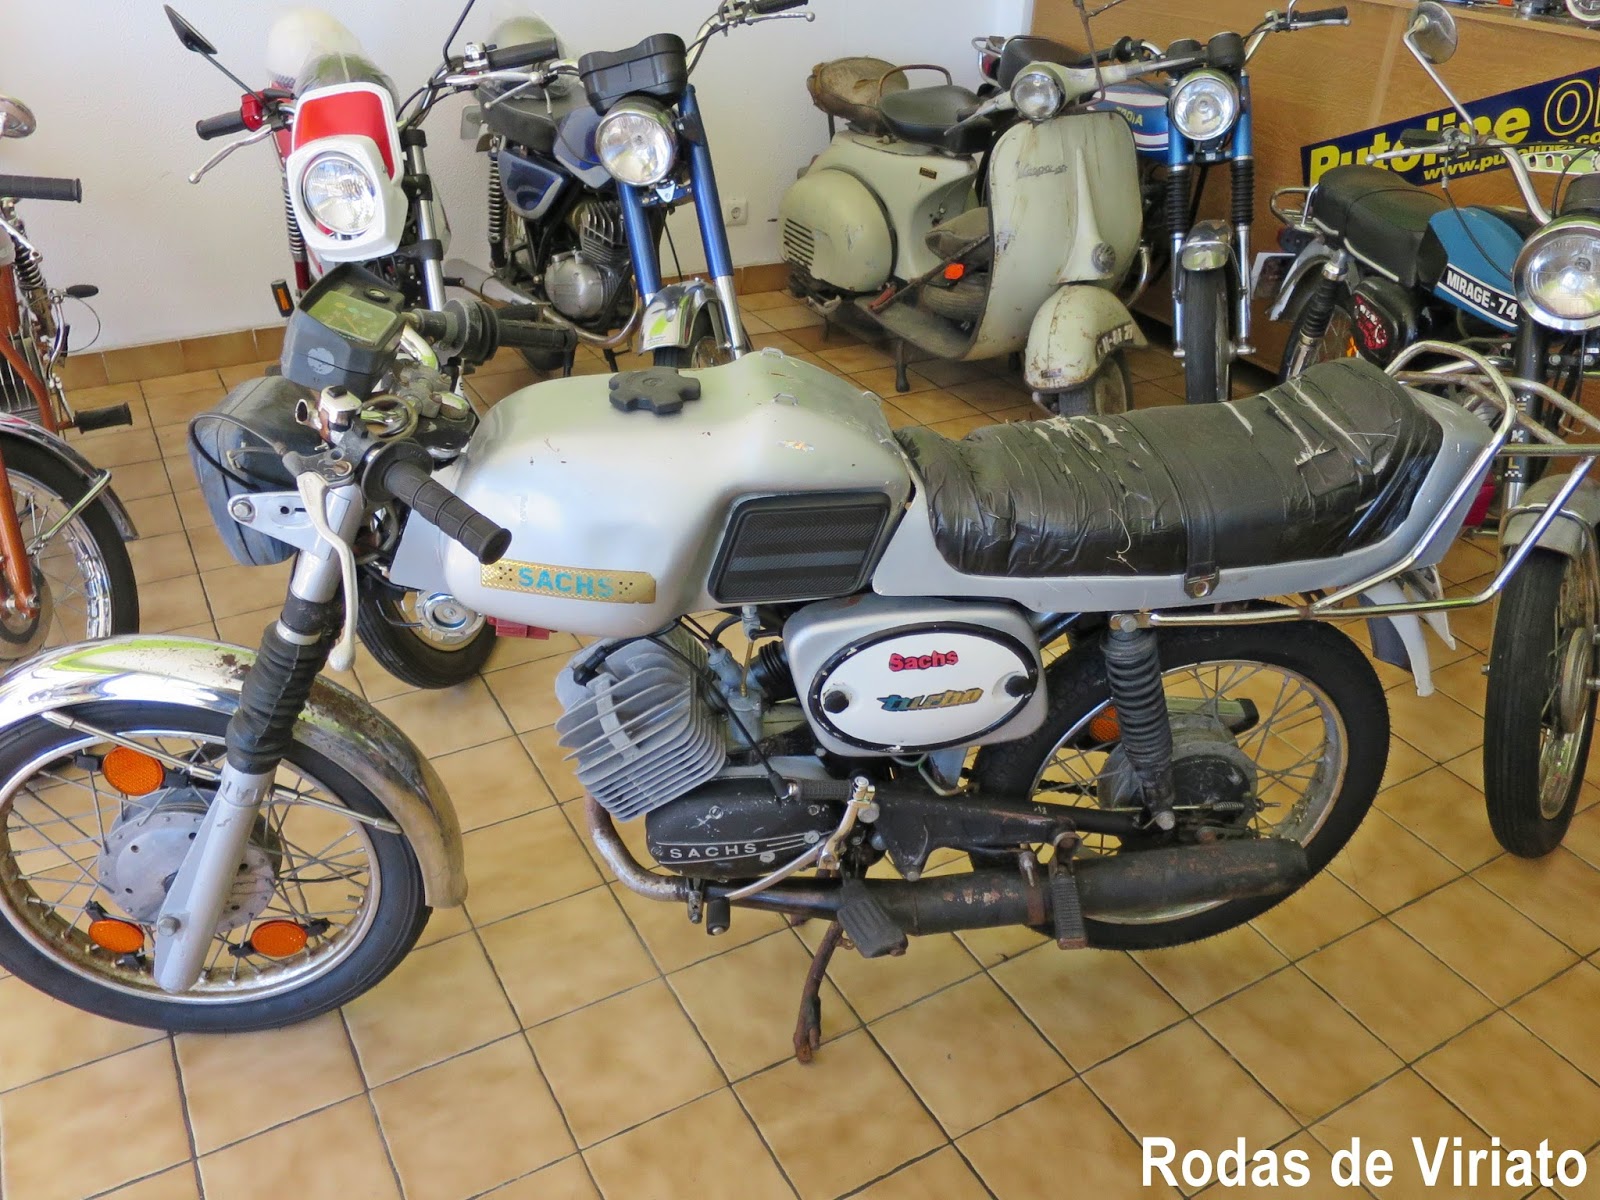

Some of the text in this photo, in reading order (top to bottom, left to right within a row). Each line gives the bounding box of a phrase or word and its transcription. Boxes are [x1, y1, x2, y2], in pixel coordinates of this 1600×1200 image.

[518, 567, 614, 598] SACHS
[888, 650, 959, 672] Sachs
[670, 842, 757, 859] SACHS
